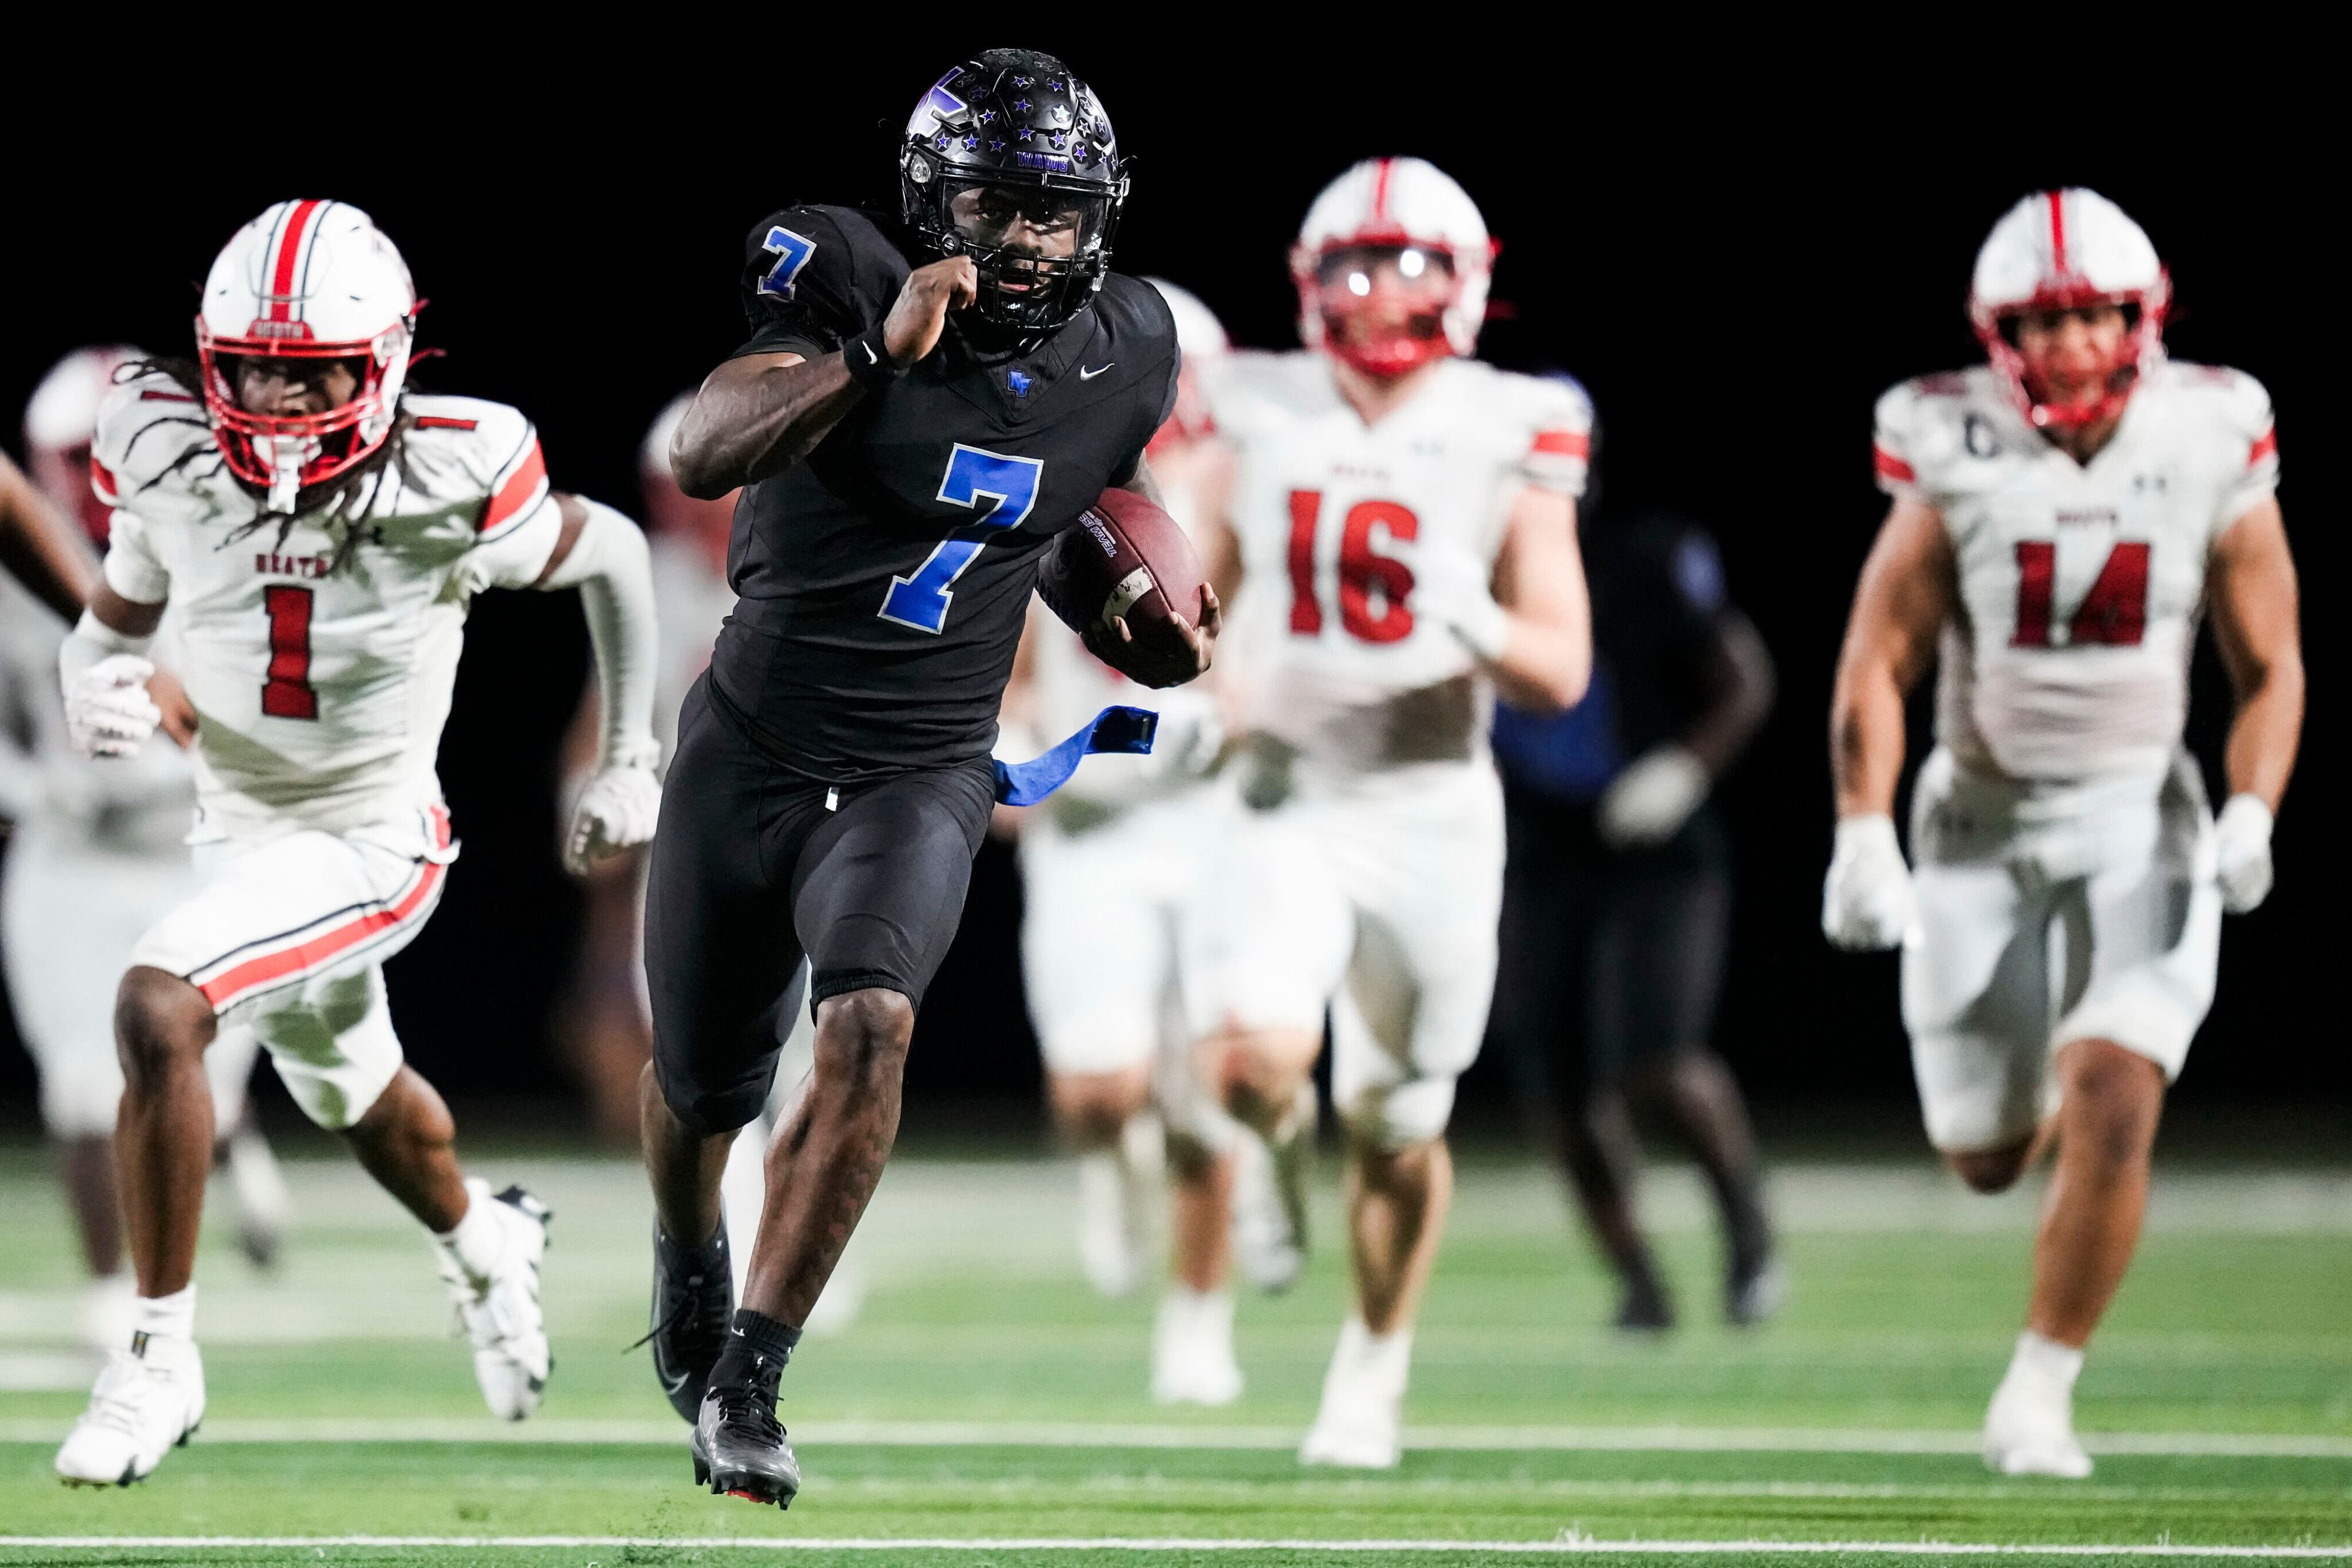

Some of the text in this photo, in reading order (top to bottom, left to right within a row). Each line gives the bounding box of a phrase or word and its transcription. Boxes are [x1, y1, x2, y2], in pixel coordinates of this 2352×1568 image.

[1016, 151, 1070, 172] WAWG
[757, 225, 818, 303] 7
[877, 442, 1044, 635] 7
[1090, 526, 1117, 558] TEAM
[1288, 488, 1418, 644] 16
[2008, 540, 2151, 650] 14
[262, 584, 319, 720] 1
